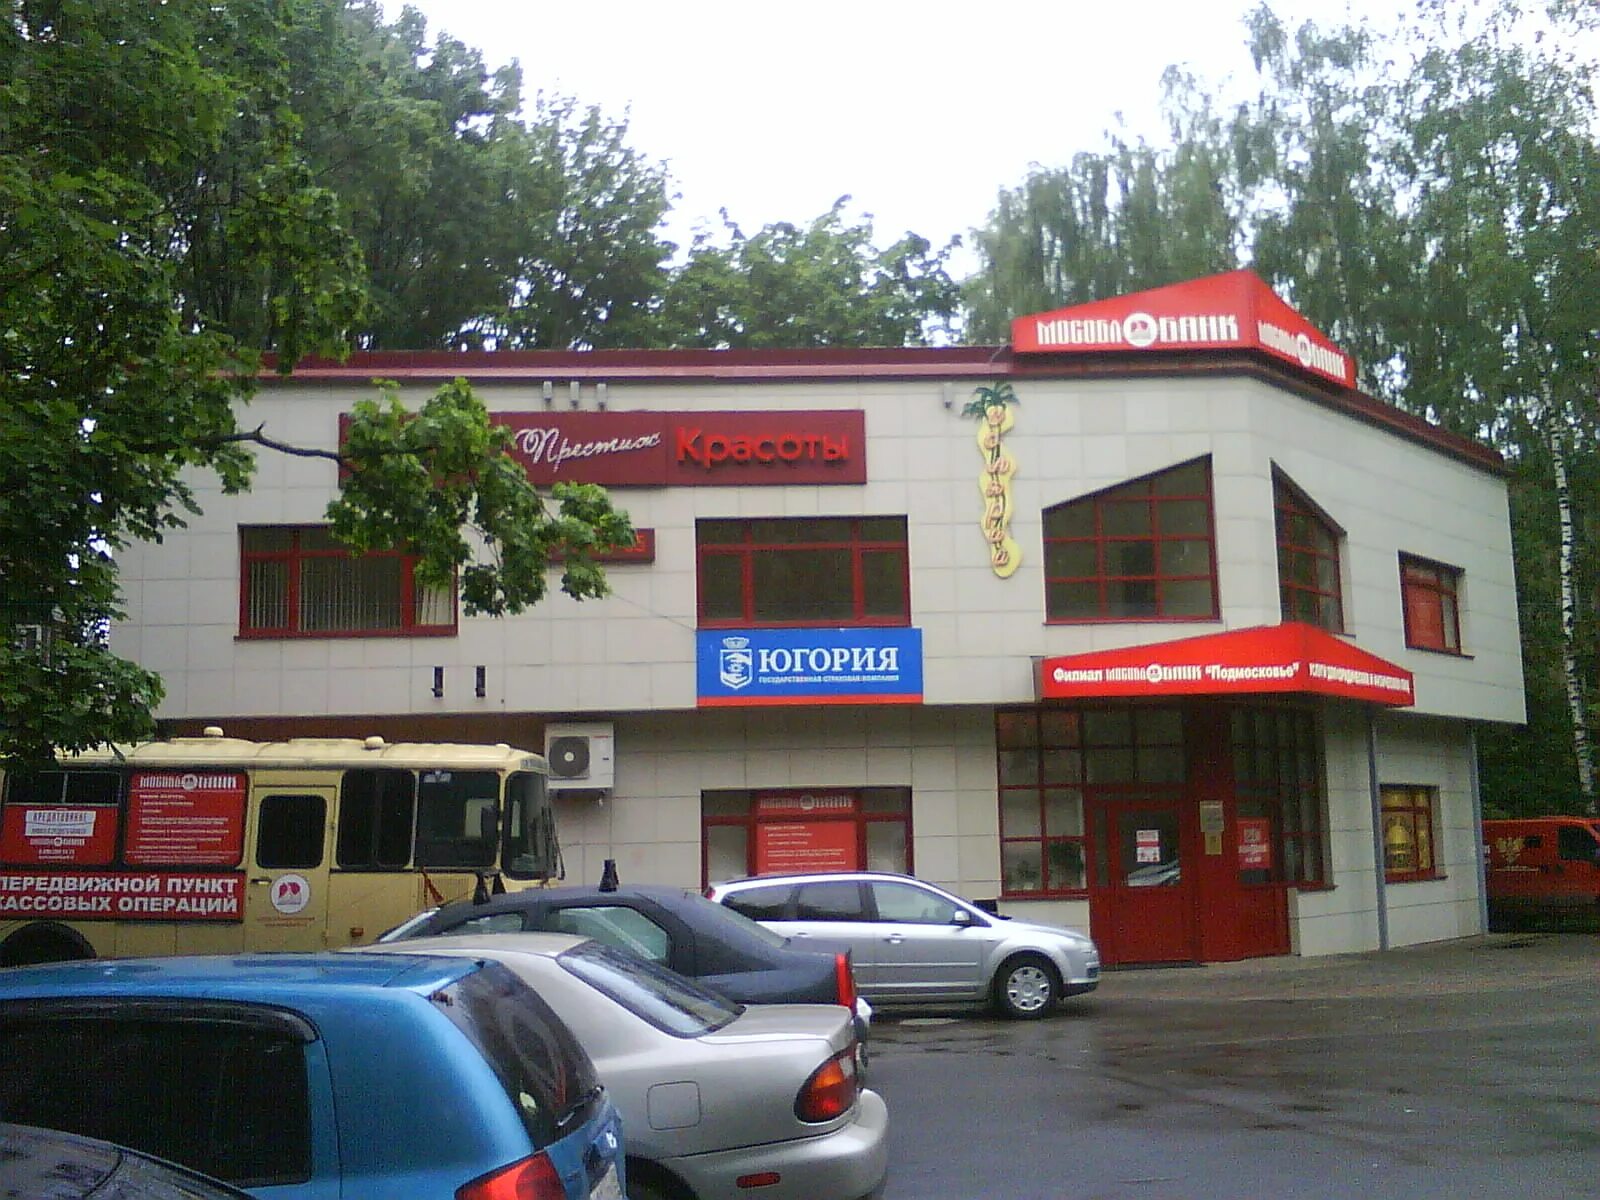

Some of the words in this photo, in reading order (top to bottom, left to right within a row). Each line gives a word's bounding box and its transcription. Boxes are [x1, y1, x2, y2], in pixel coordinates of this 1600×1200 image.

[514, 428, 661, 473] Престиж
[675, 426, 849, 468] Красоты
[758, 647, 899, 673] ЮГОРИЯ
[1053, 667, 1103, 683] Филиал
[167, 878, 238, 893] ПУНКТ
[118, 894, 238, 915] ОПЕРАЦИЙ
